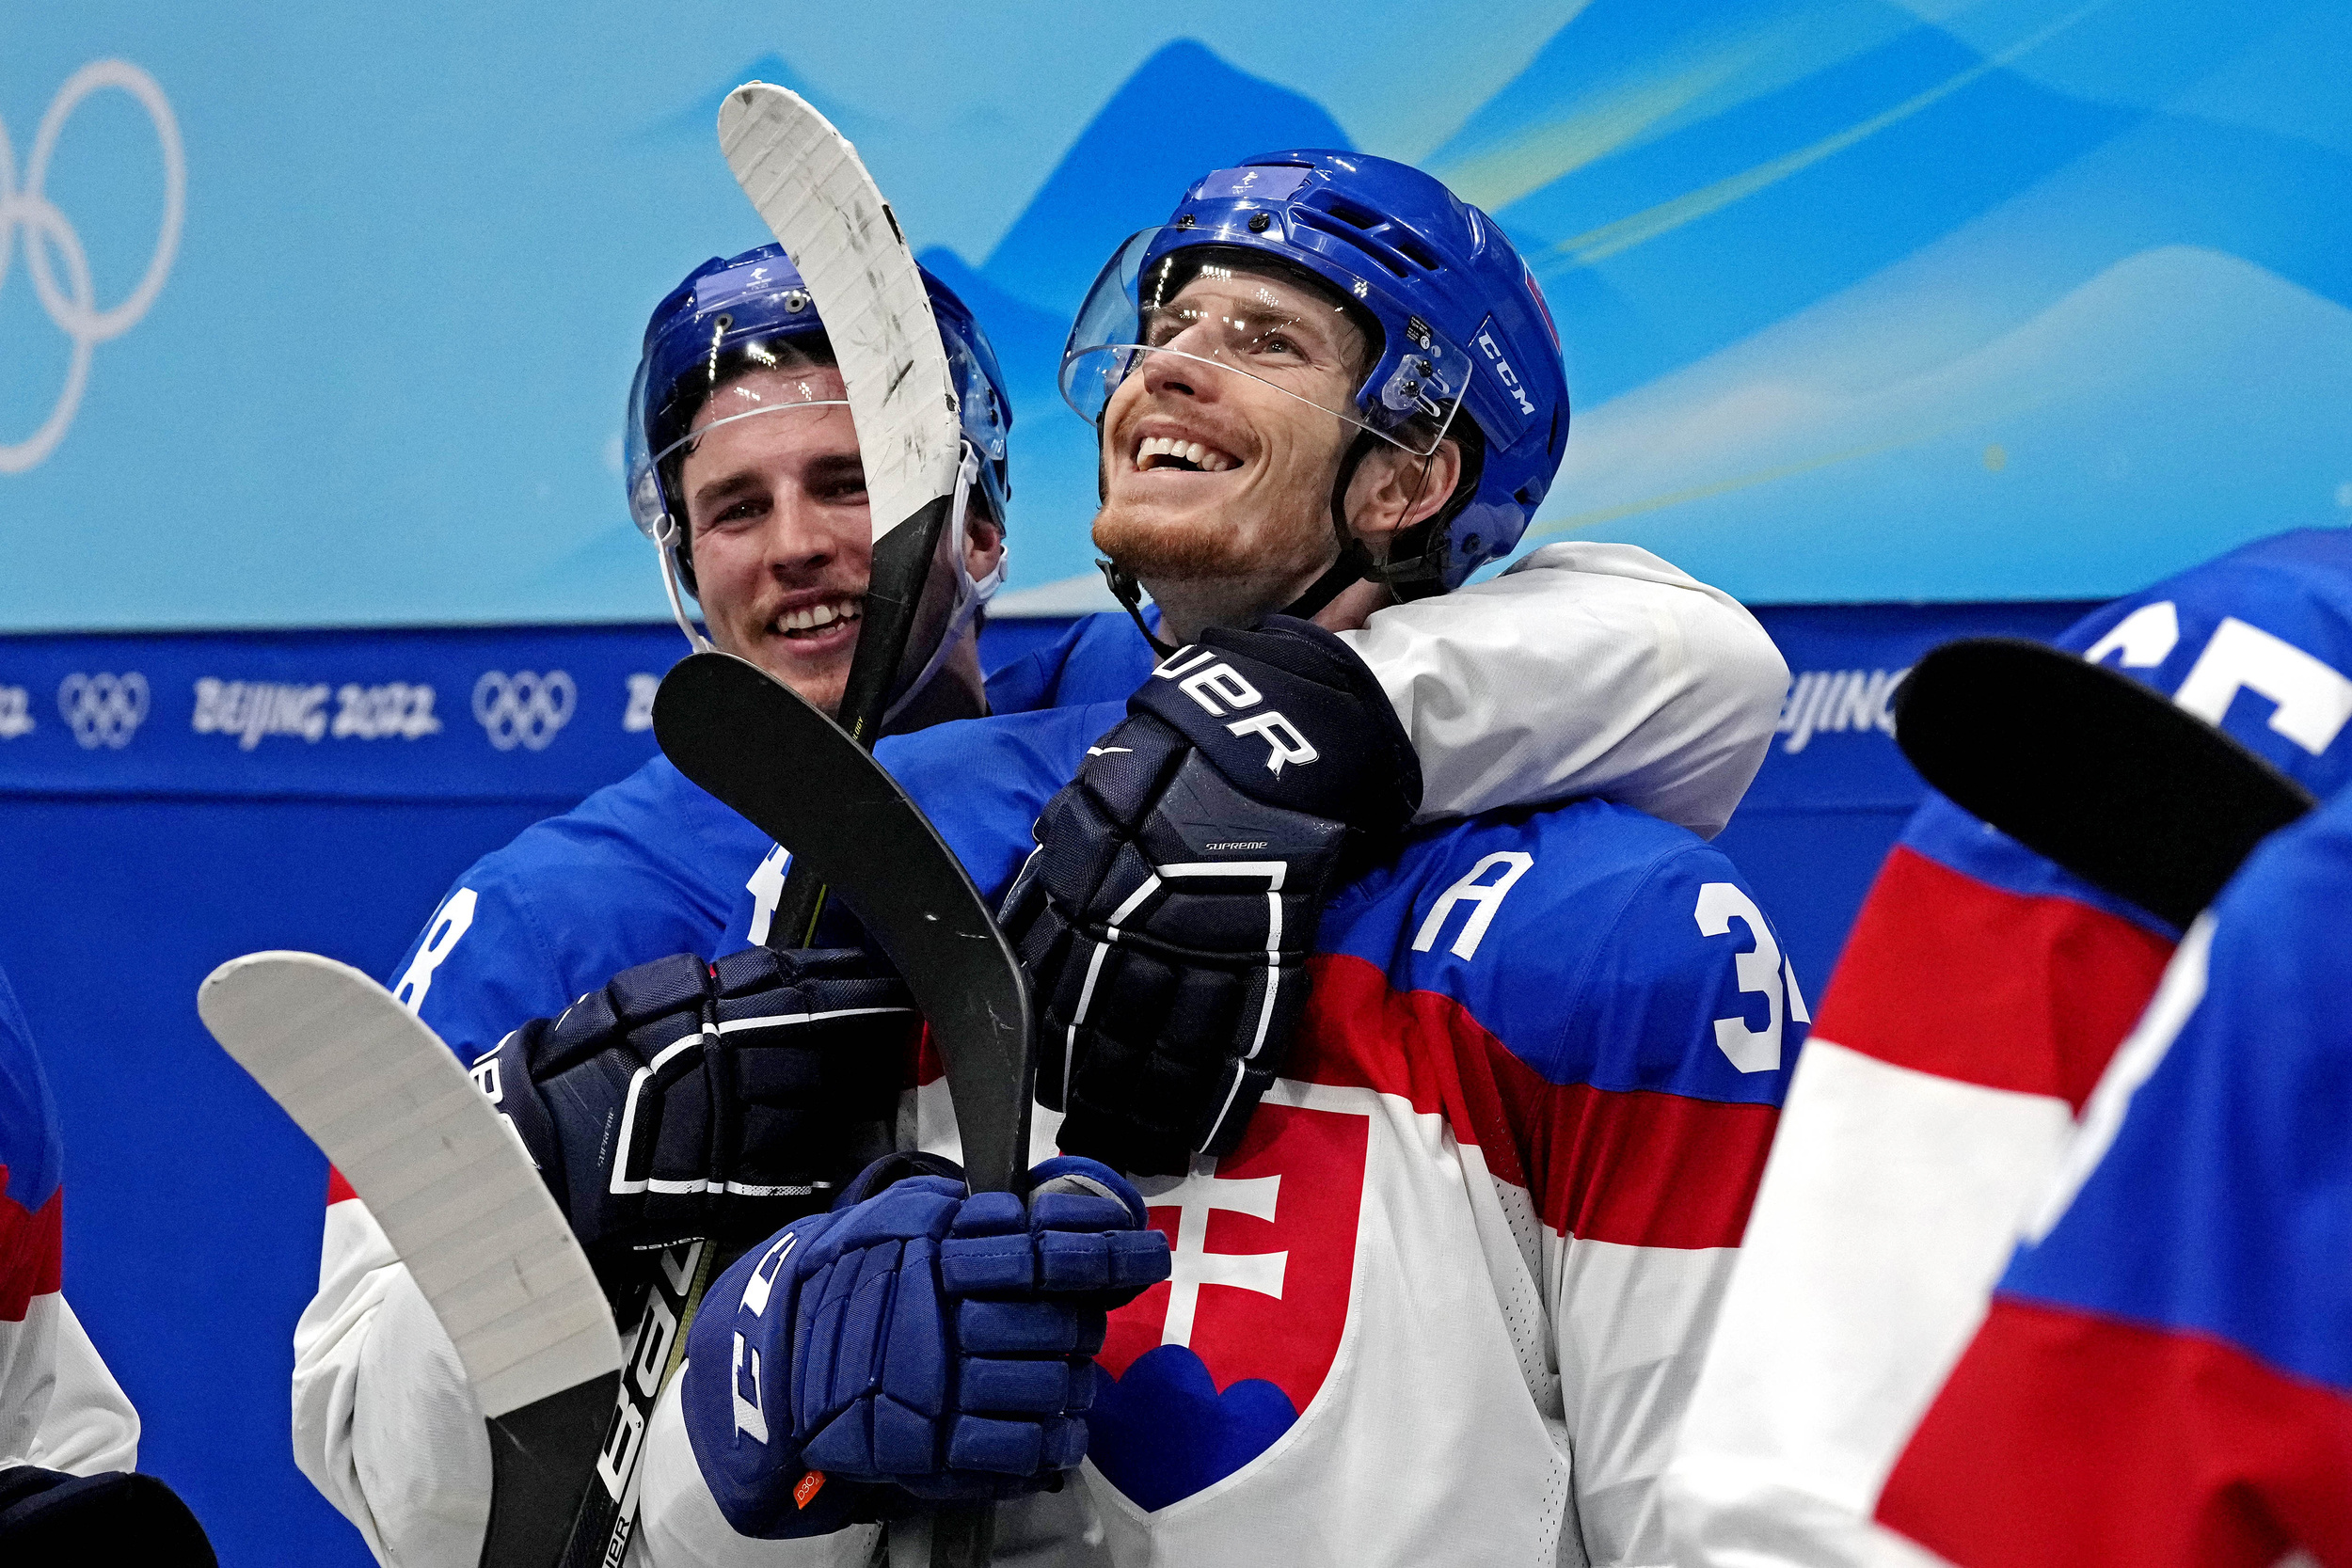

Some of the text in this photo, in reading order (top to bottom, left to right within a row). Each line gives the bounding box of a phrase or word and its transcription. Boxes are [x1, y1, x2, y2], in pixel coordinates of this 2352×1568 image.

[1478, 330, 1535, 415] CCM
[852, 716, 864, 740] LOGY
[1205, 842, 1268, 850] SUPREME
[1412, 850, 1534, 961] A
